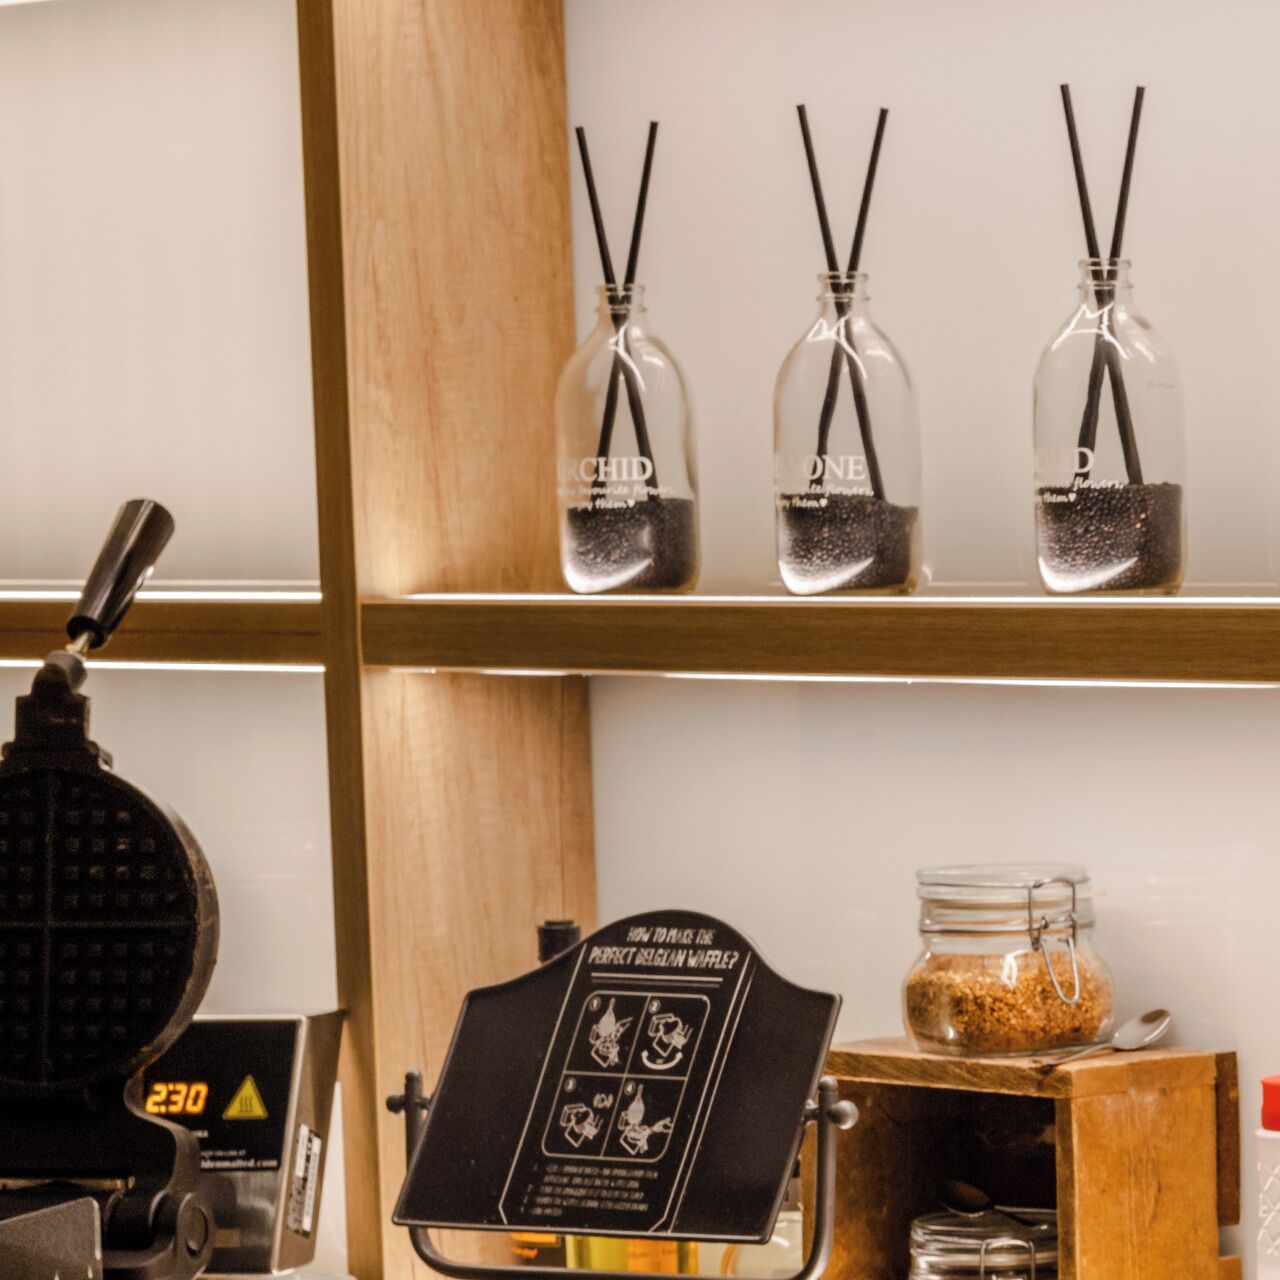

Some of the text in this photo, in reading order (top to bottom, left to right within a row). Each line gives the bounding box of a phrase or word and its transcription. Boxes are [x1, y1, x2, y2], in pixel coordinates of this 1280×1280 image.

[627, 926, 651, 942] HOW
[652, 926, 667, 943] TO
[667, 927, 695, 944] MAKE
[588, 946, 740, 970] PERFECT BELGIAN WAFFLE?
